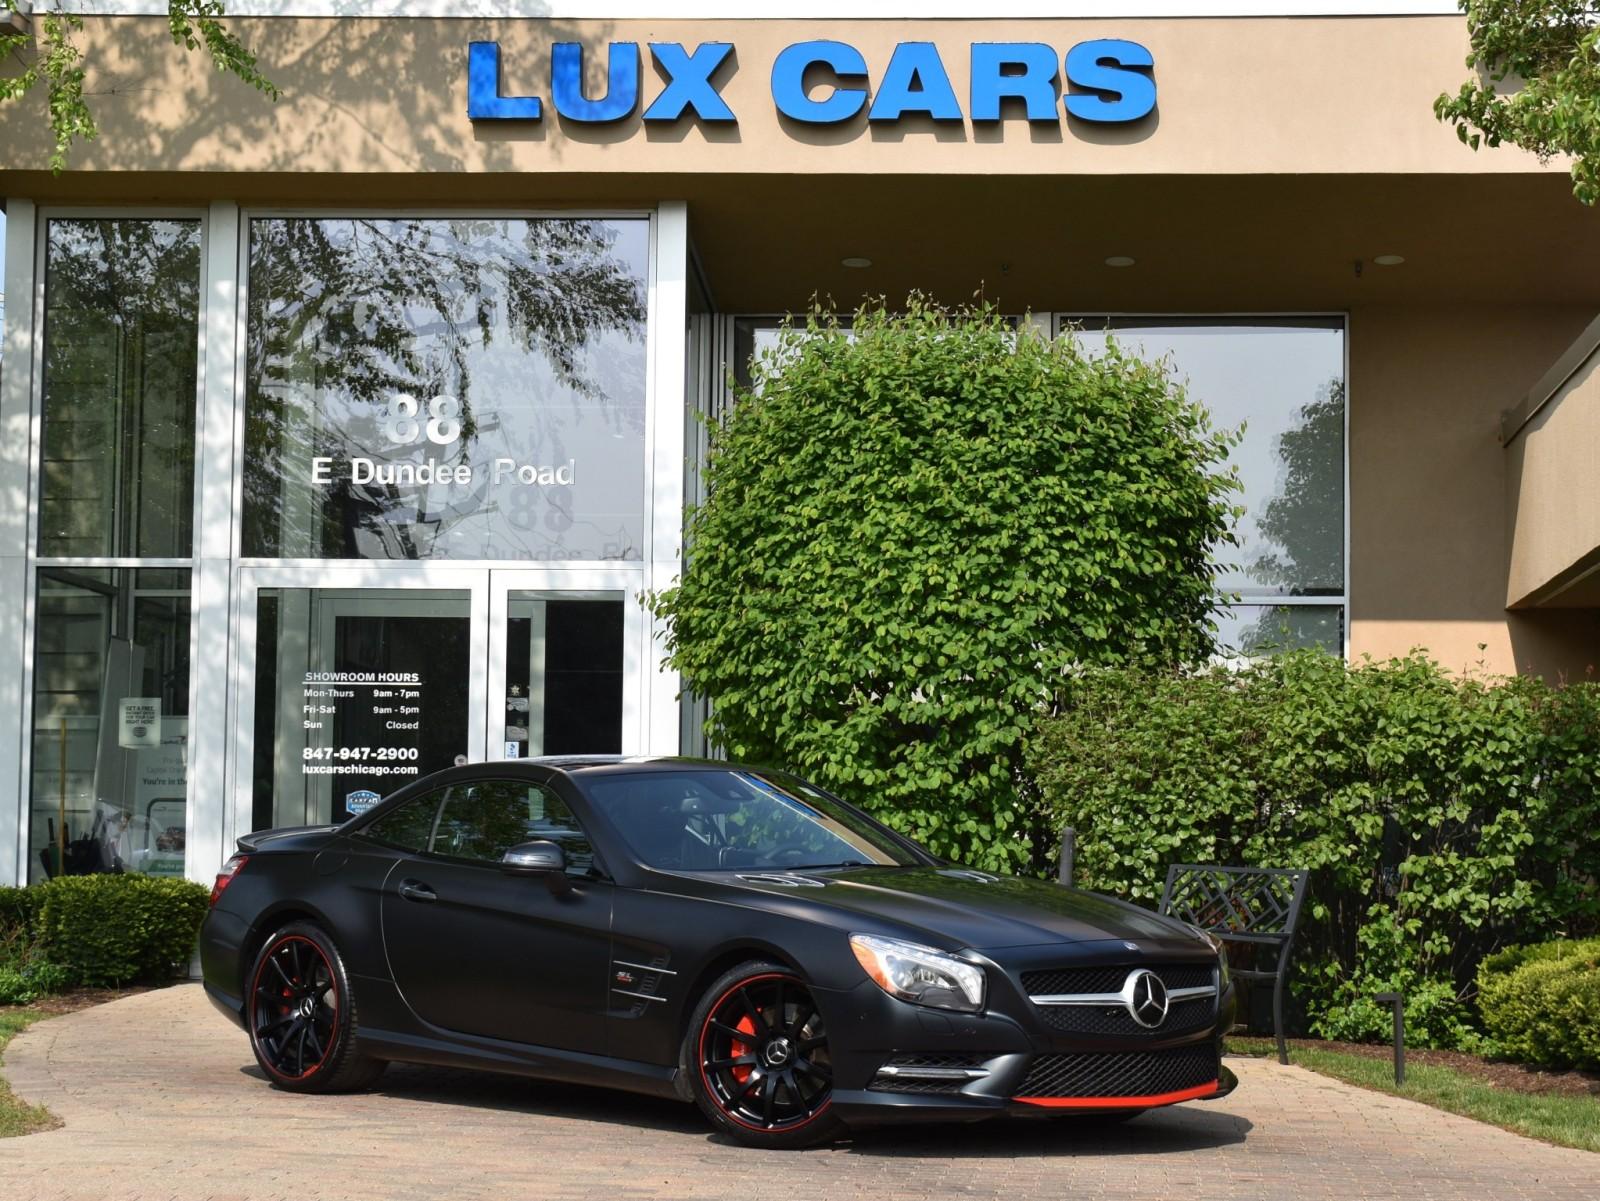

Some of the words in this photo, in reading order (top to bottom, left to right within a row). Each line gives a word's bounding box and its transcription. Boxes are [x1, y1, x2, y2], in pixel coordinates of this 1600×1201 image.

[467, 41, 738, 123] LUX
[770, 38, 1158, 125] CARS
[385, 393, 461, 444] 88
[311, 457, 333, 484] E
[351, 457, 472, 485] Dundee
[494, 458, 576, 485] Road
[305, 672, 376, 681] SHOWROOM
[378, 673, 419, 682] HOURS
[303, 689, 355, 698] Mon-Thurs
[373, 689, 393, 698] 9am
[400, 689, 420, 699] 7pm
[303, 705, 336, 714] Fri-Sat
[373, 706, 393, 714] 9am
[400, 706, 420, 715] 5pm
[303, 720, 323, 729] Sun
[386, 721, 419, 729] Closed
[302, 747, 419, 760] 847-947-2900
[302, 764, 419, 776] luxcarschicago.com
